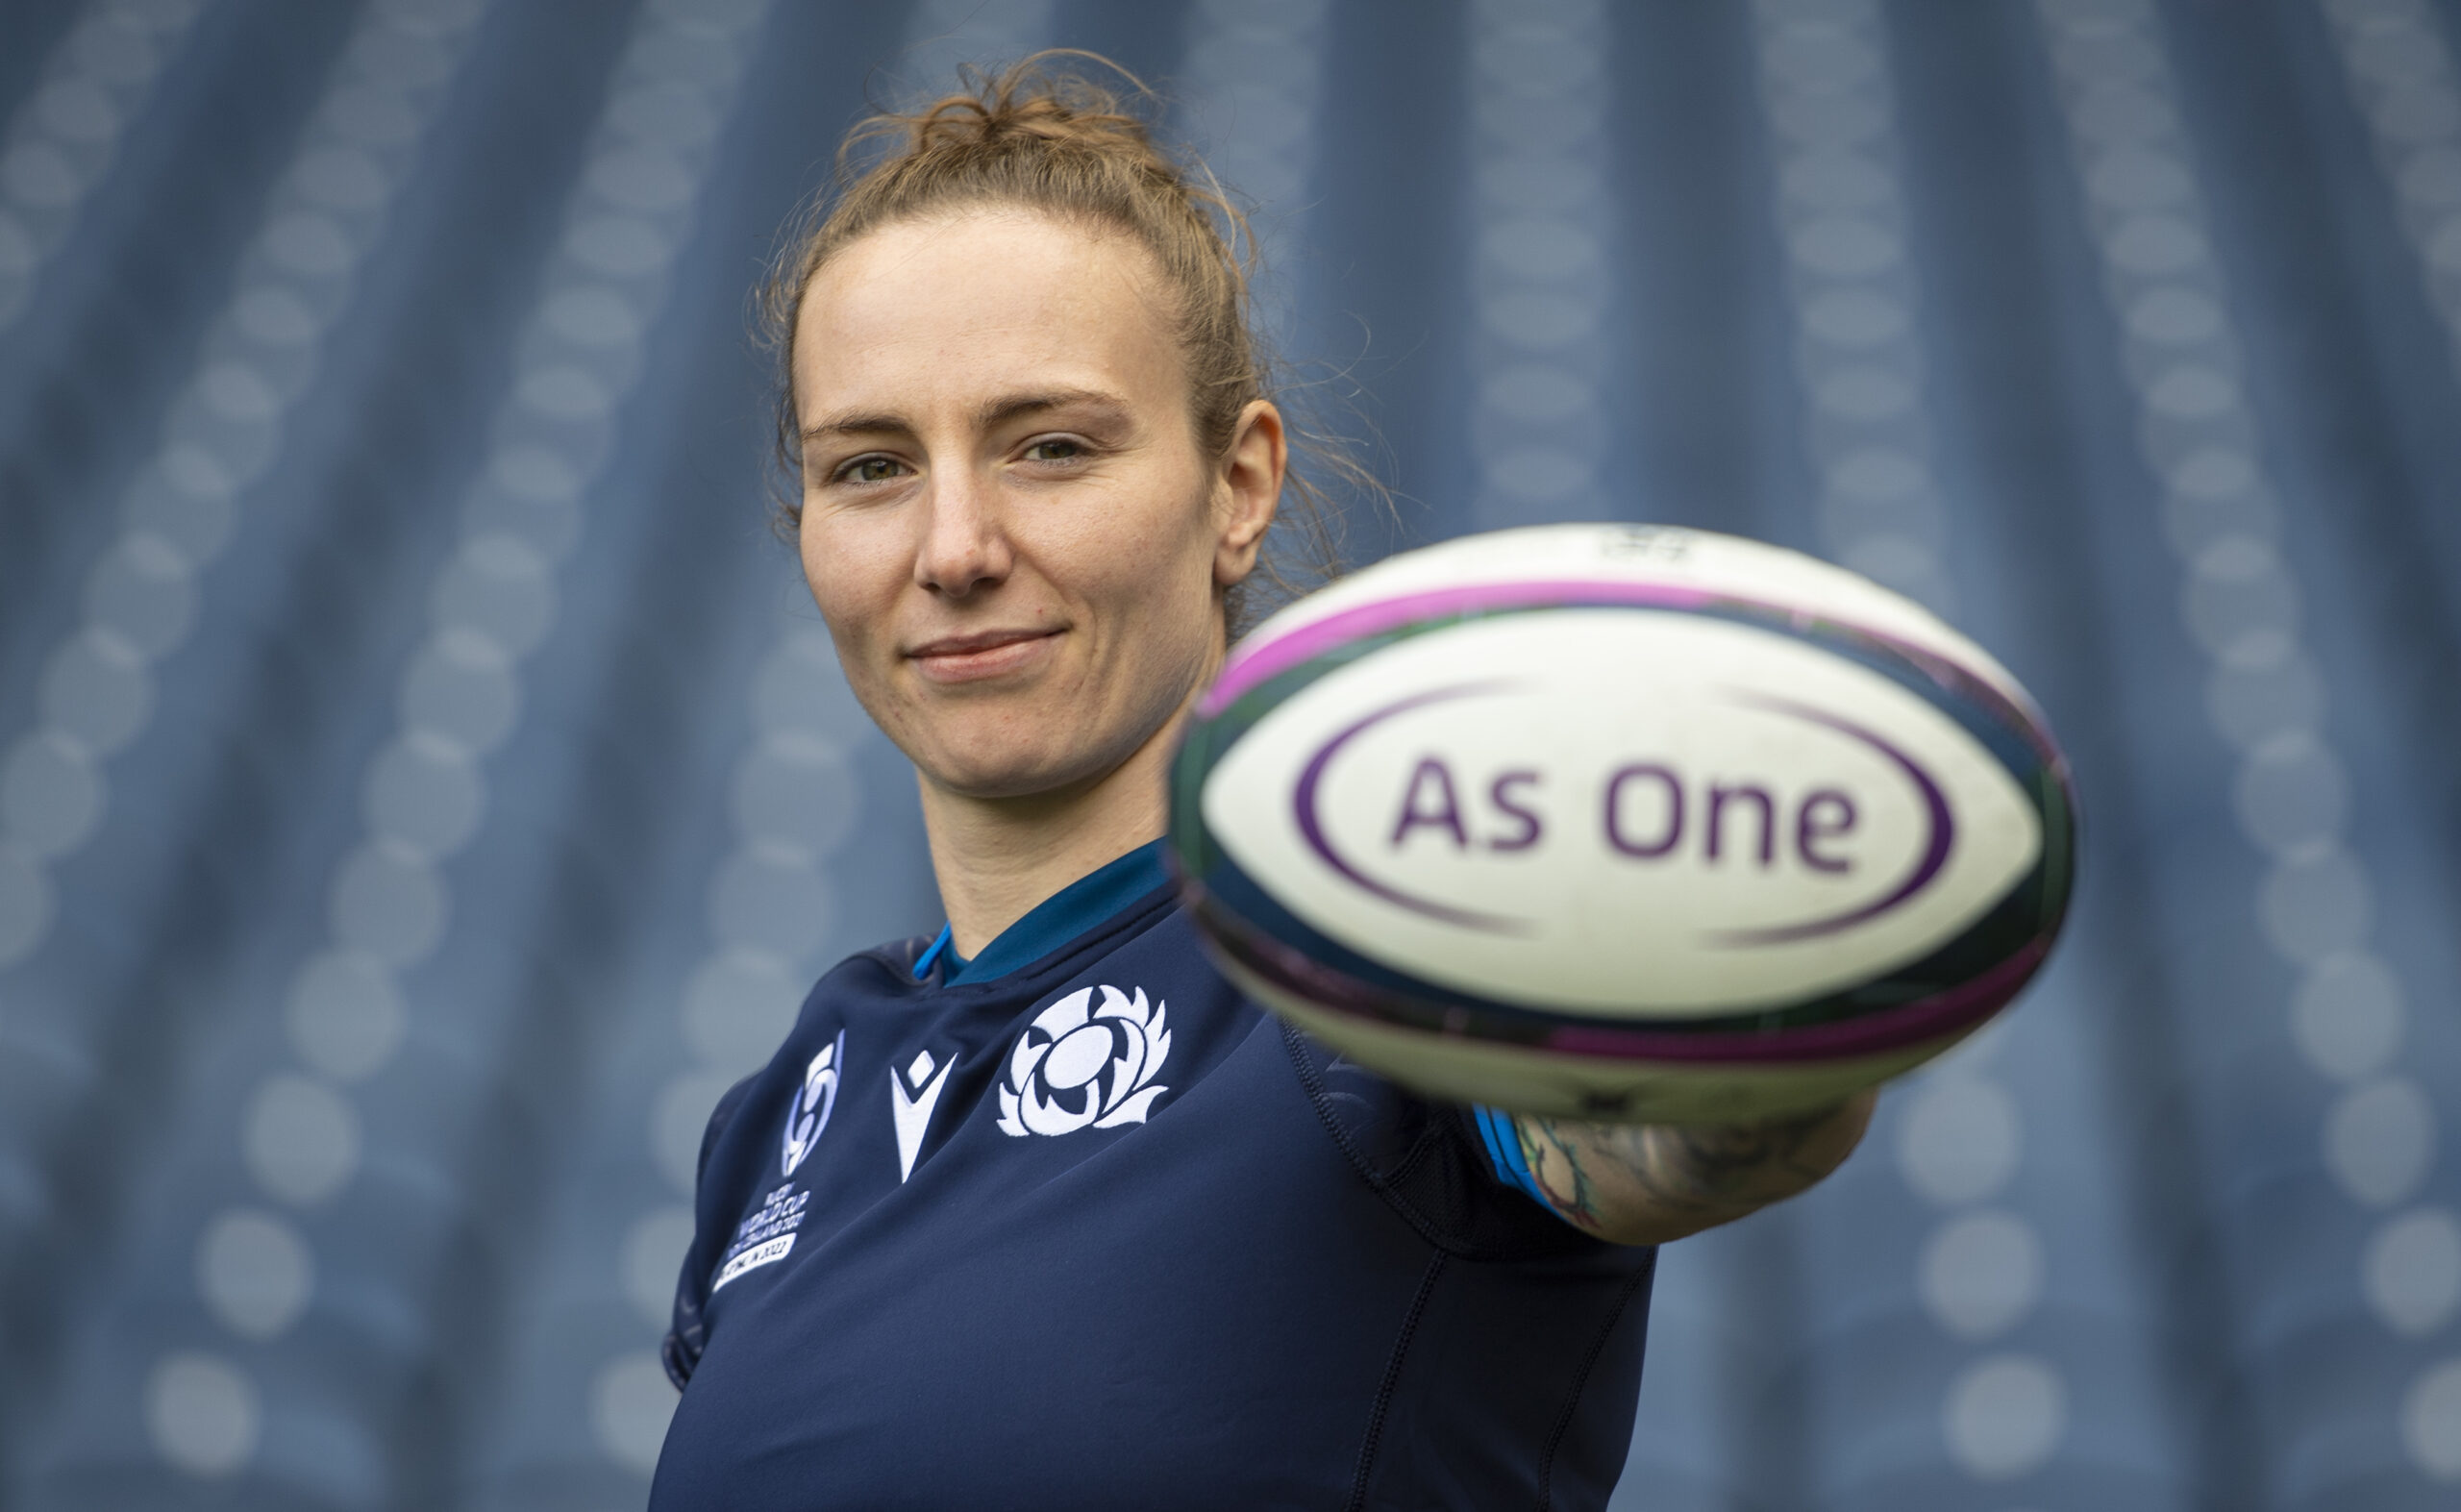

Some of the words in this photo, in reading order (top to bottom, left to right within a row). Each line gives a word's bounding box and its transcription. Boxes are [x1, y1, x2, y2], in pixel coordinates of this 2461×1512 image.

[1389, 755, 1544, 853] As
[1602, 763, 1860, 876] One
[781, 1189, 810, 1217] CUP
[759, 1240, 787, 1260] 2022
